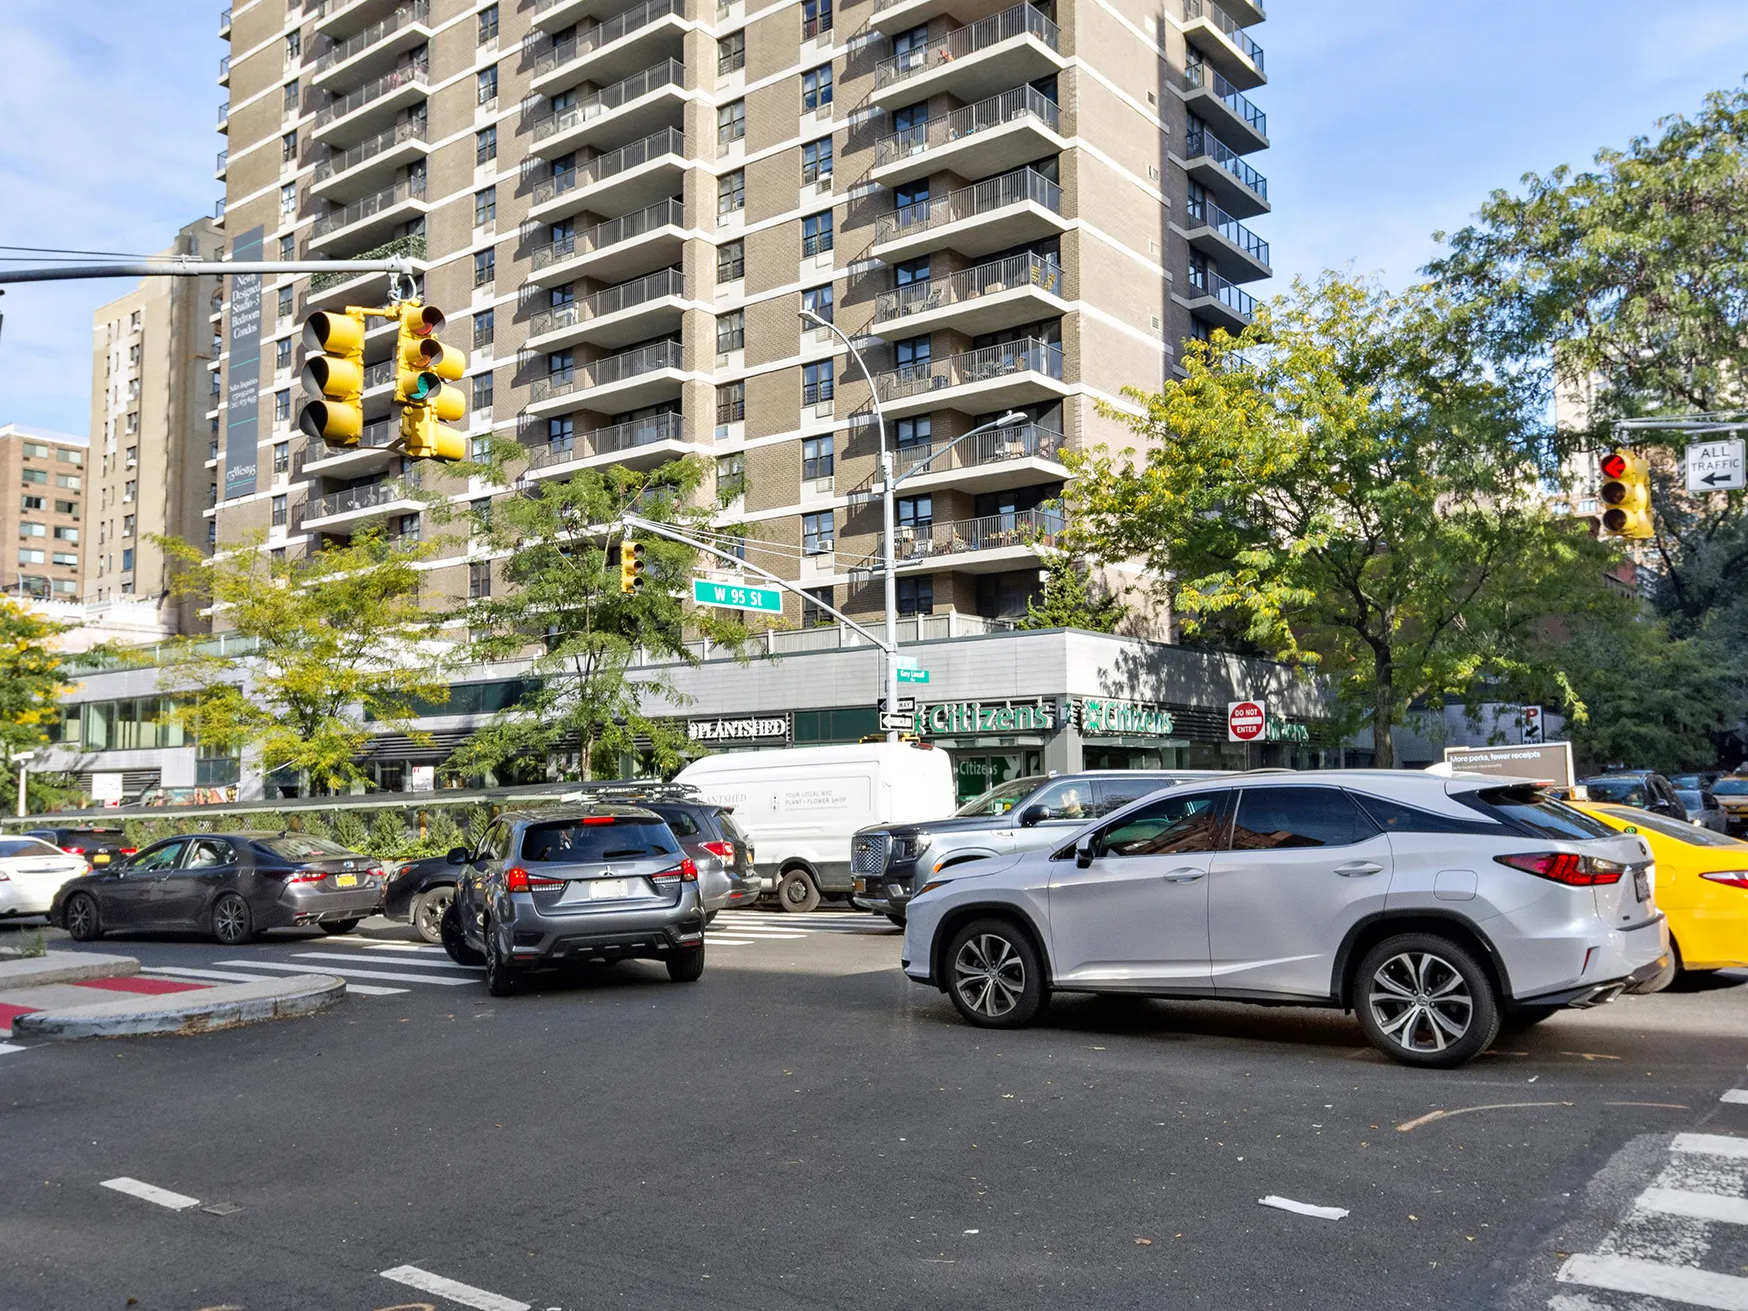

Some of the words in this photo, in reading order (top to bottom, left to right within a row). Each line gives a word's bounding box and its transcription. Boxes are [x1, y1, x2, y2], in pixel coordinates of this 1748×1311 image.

[232, 281, 261, 302] Designed
[232, 310, 260, 328] Bedroom
[233, 323, 257, 339] Condos
[1700, 446, 1731, 458] ALL
[1691, 459, 1740, 471] TRAFFIC
[714, 586, 726, 601] W
[731, 589, 746, 604] 95
[750, 591, 763, 606] St
[929, 702, 1051, 733] Citizens
[1104, 702, 1173, 734] Citizens
[1234, 709, 1244, 717] DO
[1245, 708, 1258, 716] NOT
[1525, 708, 1538, 725] P
[697, 719, 786, 739] PLANTSHED
[1469, 754, 1490, 762] perks,
[1511, 751, 1541, 759] receipts
[959, 760, 998, 775] Citizes
